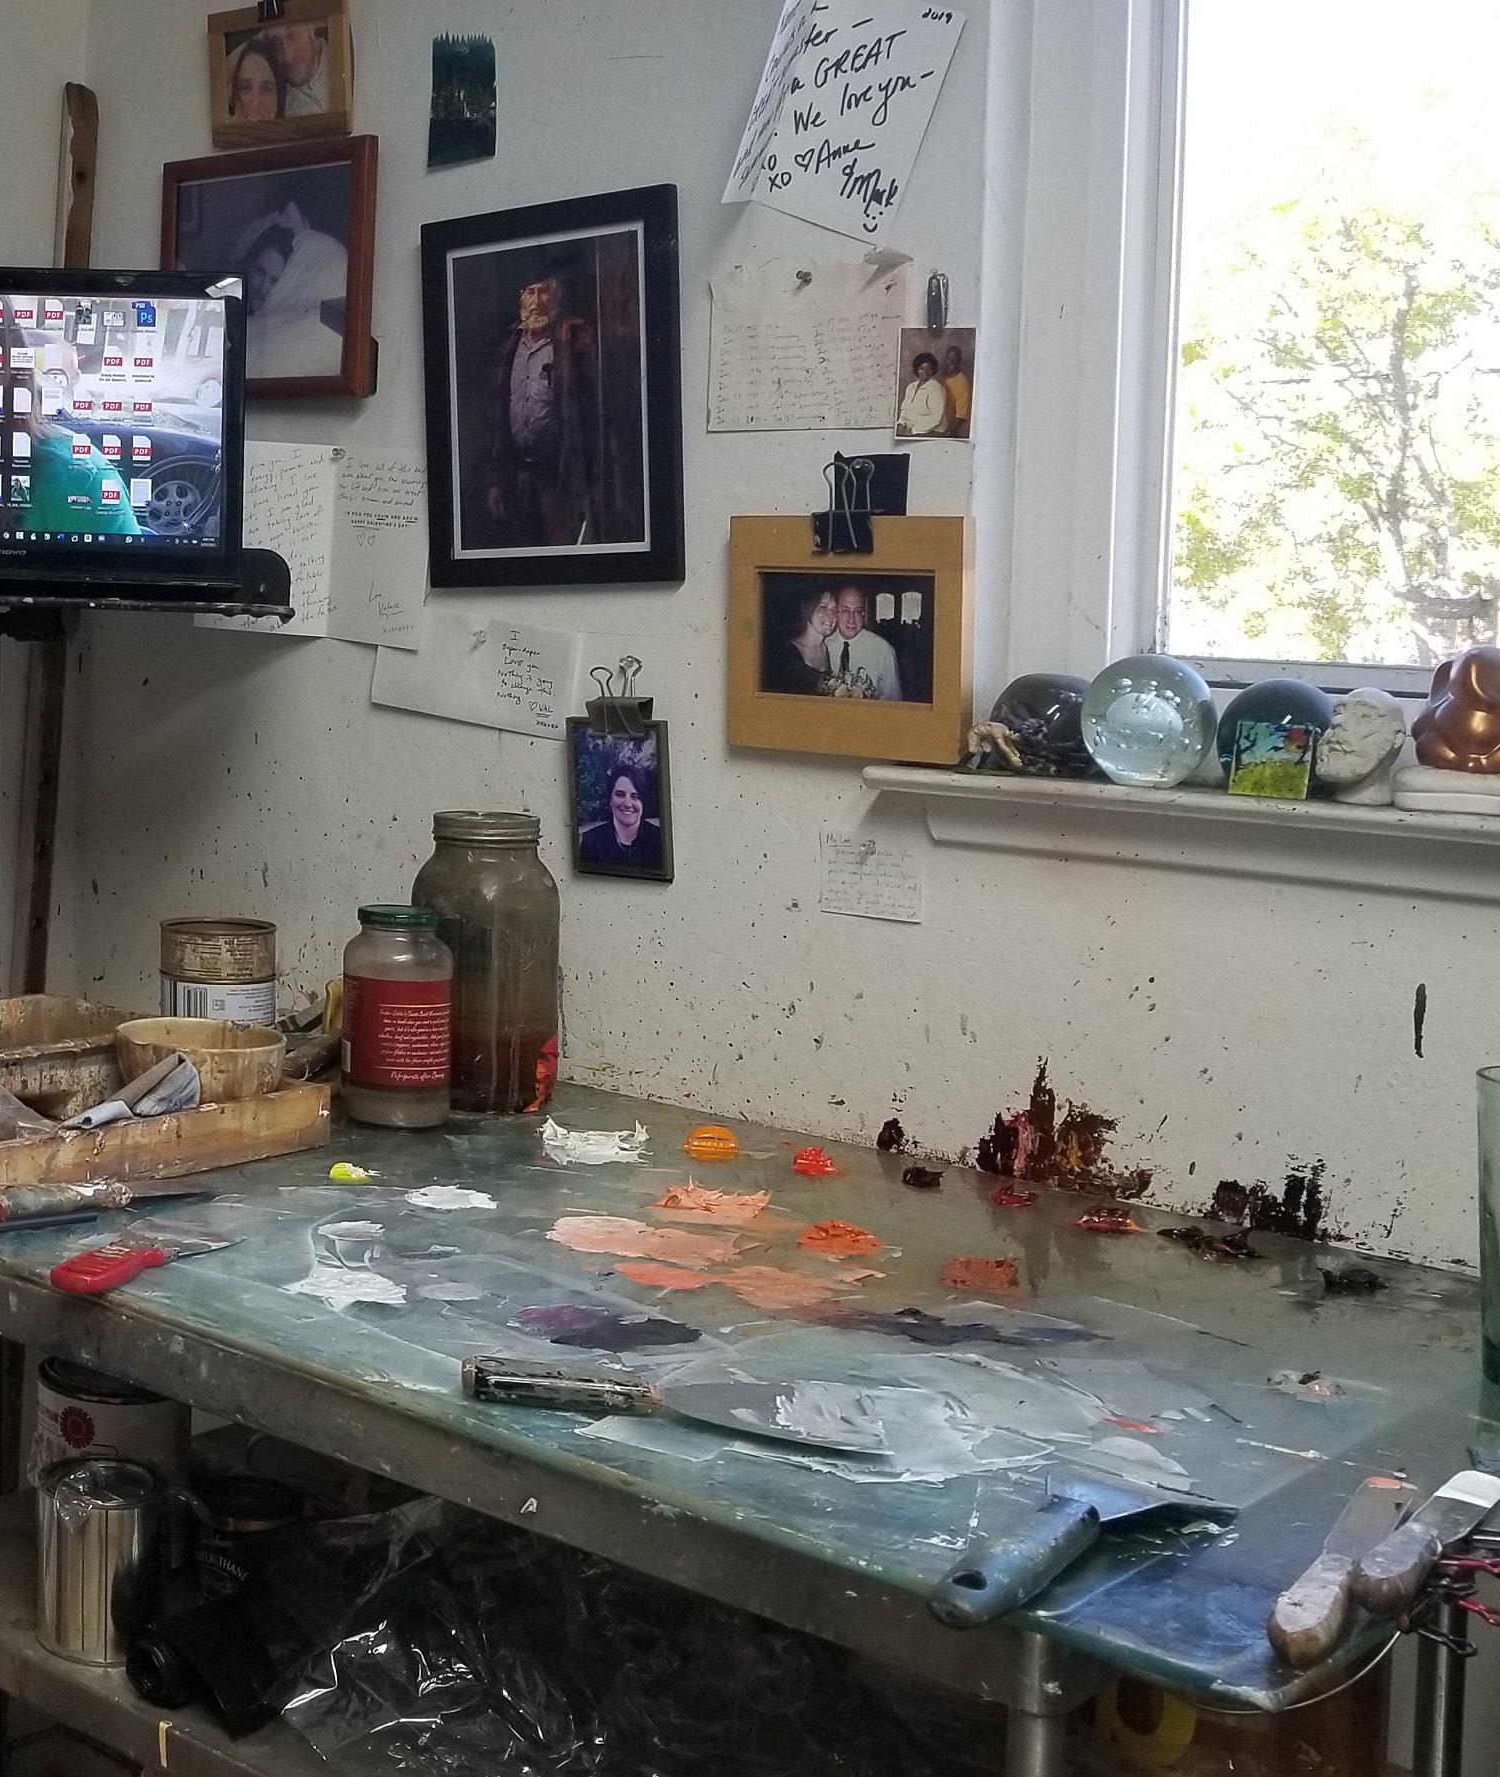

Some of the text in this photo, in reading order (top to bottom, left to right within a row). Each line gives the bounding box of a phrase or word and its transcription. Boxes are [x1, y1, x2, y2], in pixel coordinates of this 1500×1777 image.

[814, 30, 907, 89] GREAT
[793, 102, 827, 135] We
[840, 82, 873, 117] love
[140, 312, 153, 323] Ps
[510, 630, 521, 641] I
